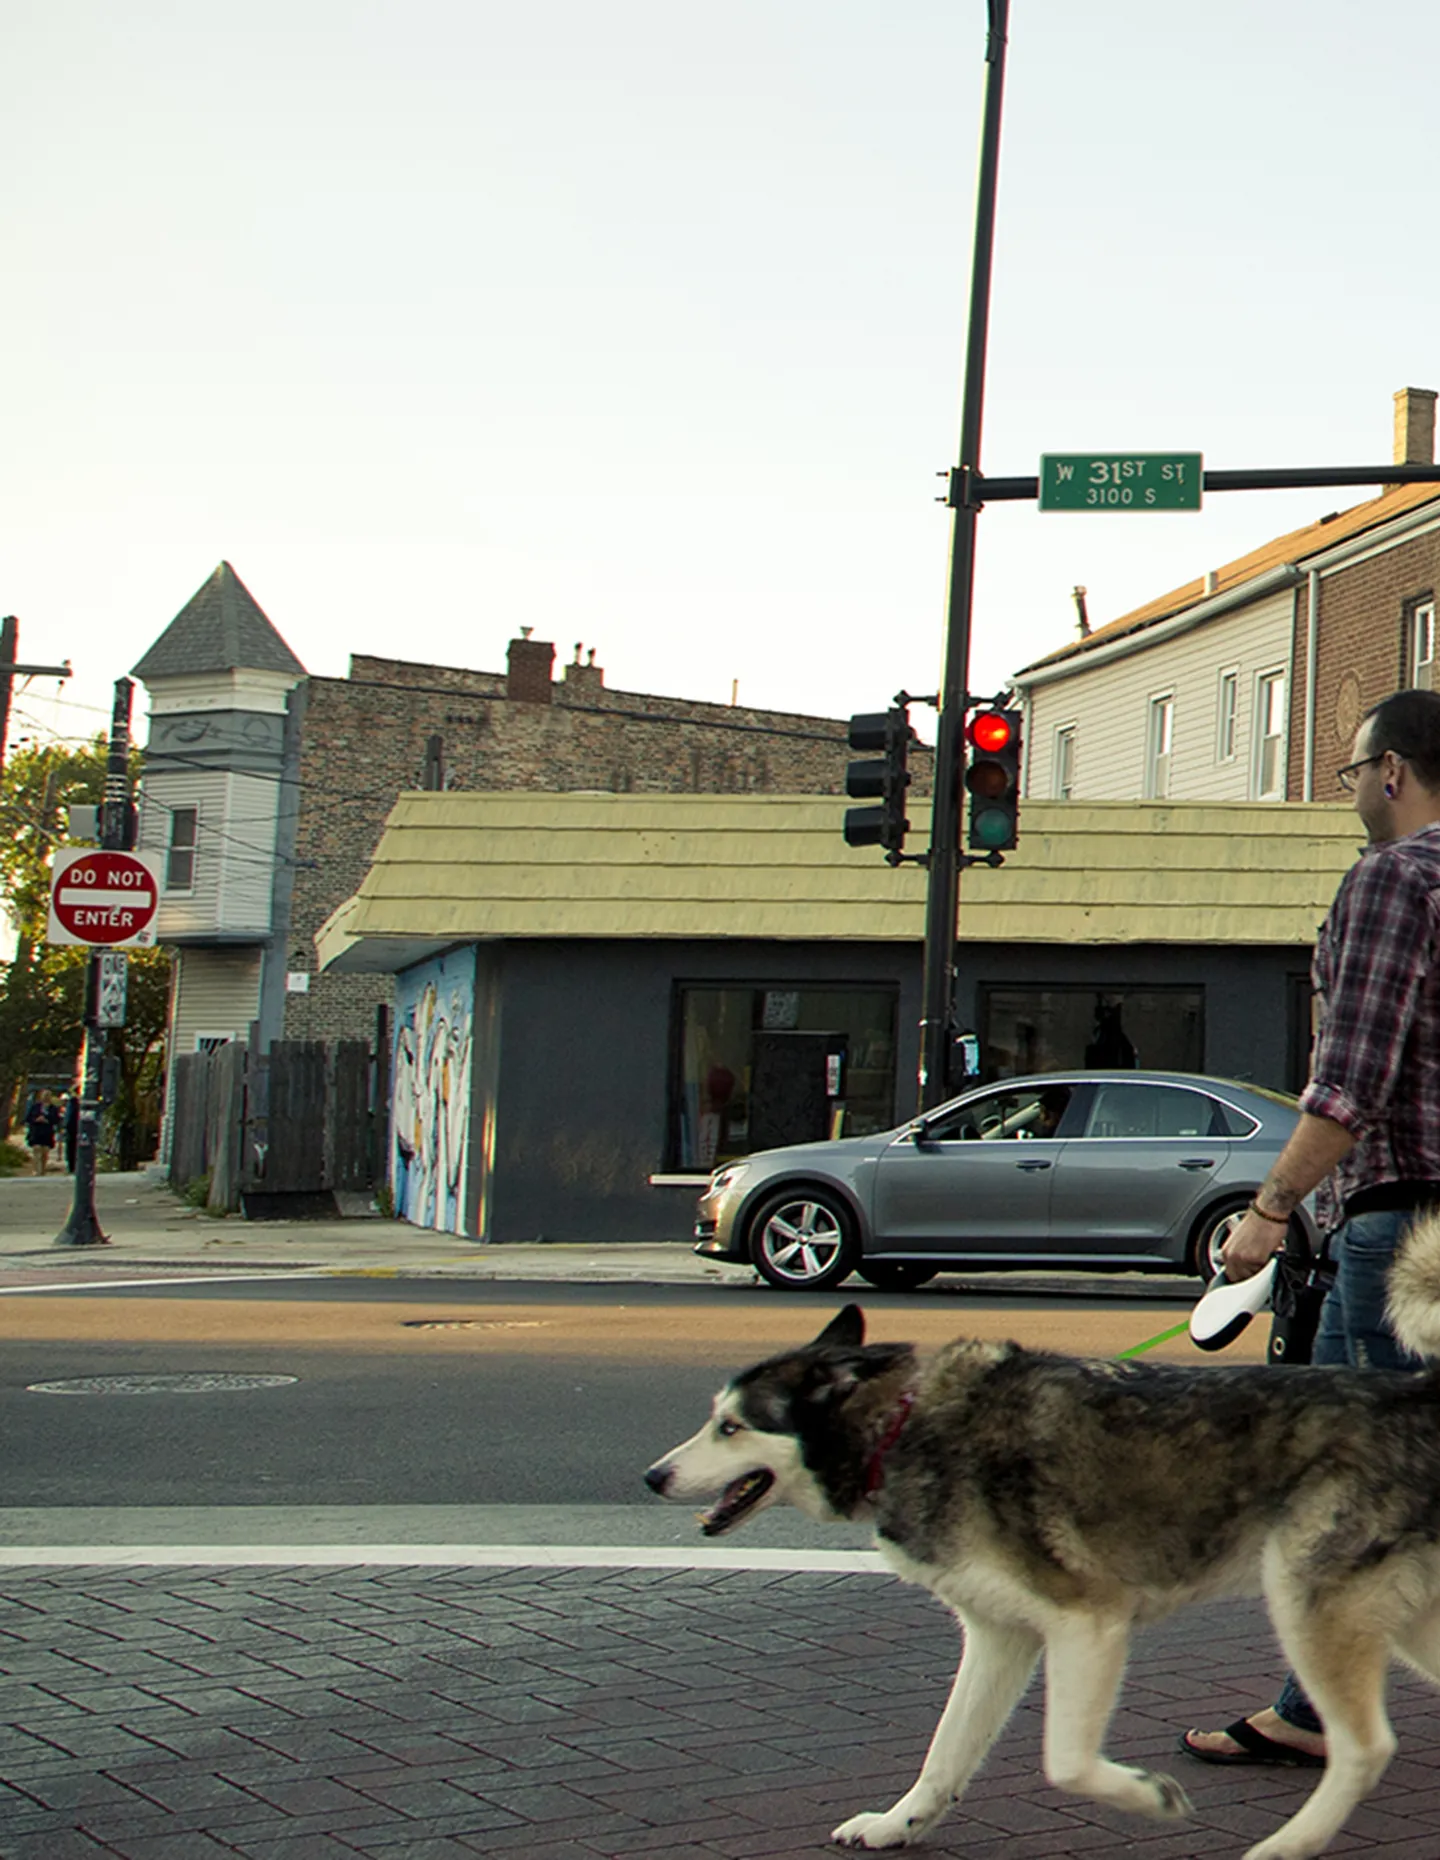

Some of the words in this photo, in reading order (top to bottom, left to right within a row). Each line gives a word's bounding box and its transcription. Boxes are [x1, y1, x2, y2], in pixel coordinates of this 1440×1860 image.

[1056, 464, 1074, 483] W
[1089, 461, 1146, 484] 31ST
[1161, 464, 1184, 483] ST
[1087, 488, 1133, 504] 3100
[1145, 488, 1156, 504] S
[70, 869, 97, 884] DO
[107, 871, 144, 886] NOT
[74, 910, 133, 927] ENTER
[103, 956, 125, 976] ONE
